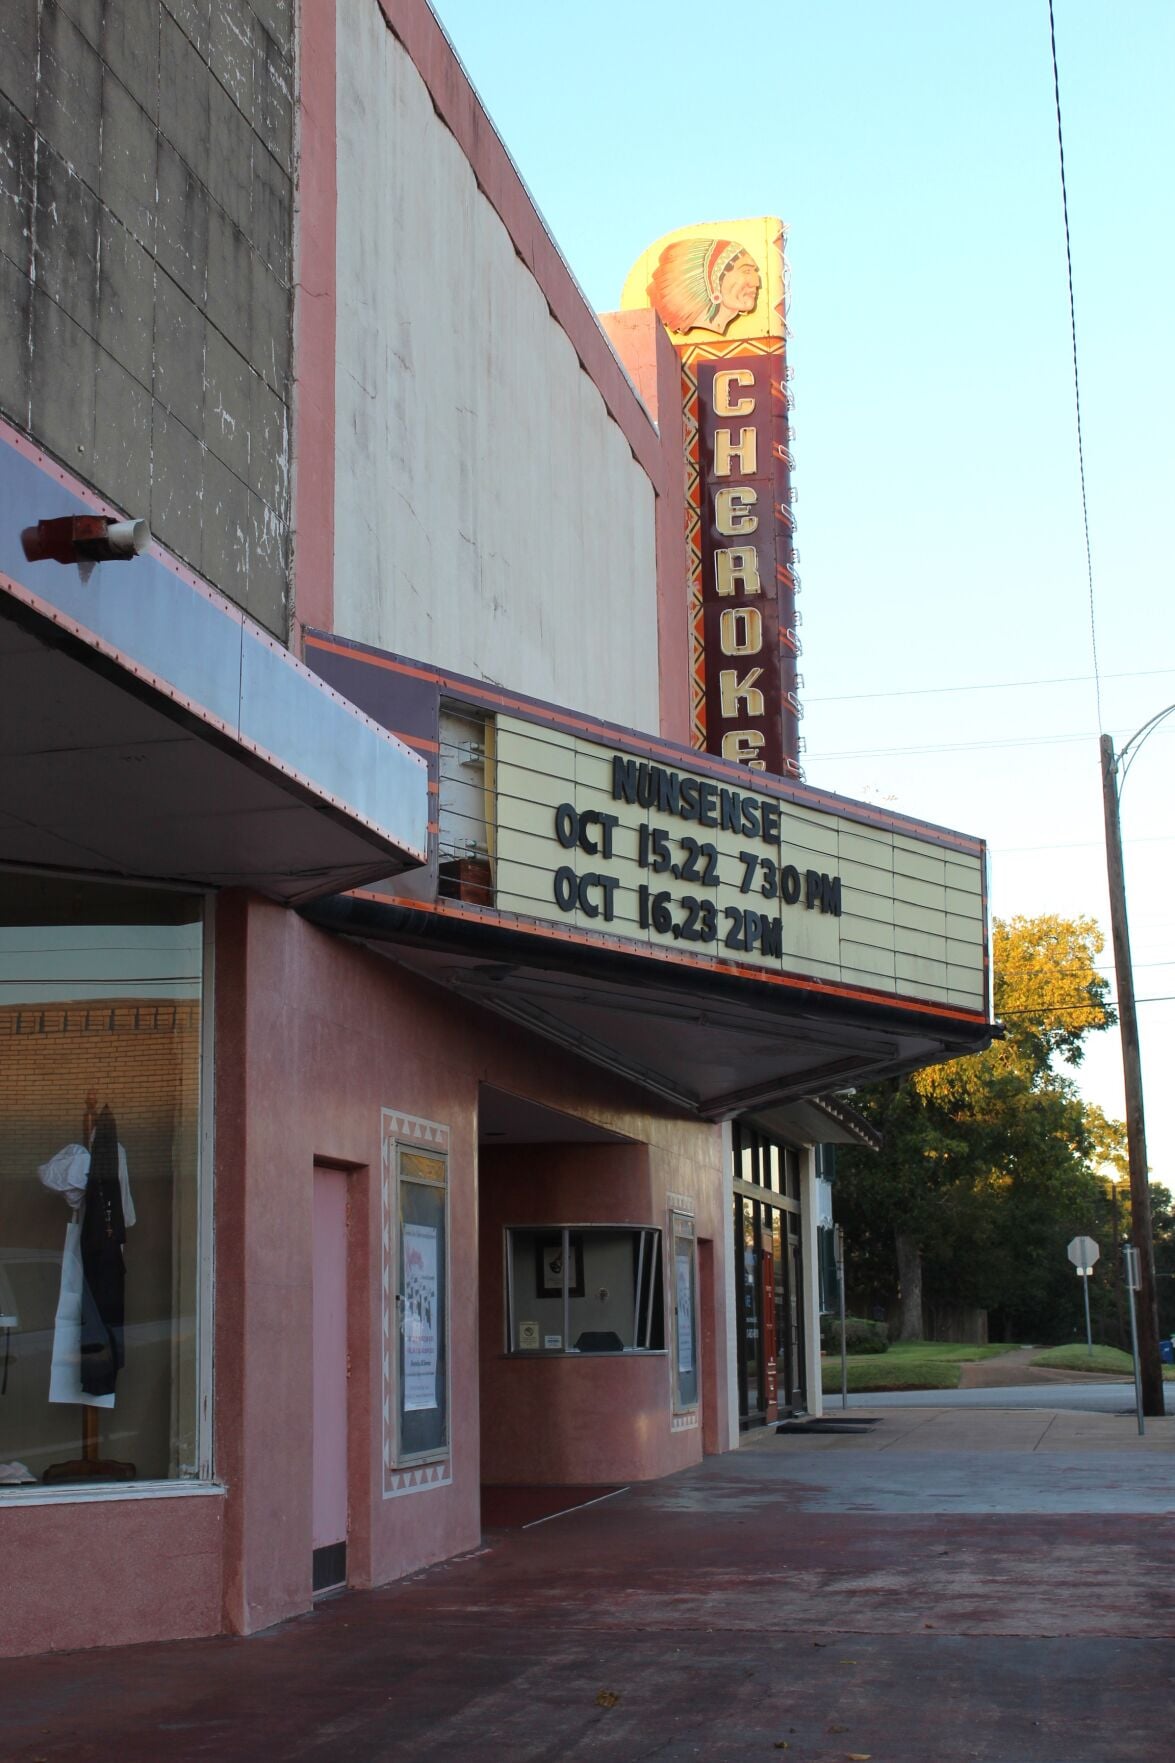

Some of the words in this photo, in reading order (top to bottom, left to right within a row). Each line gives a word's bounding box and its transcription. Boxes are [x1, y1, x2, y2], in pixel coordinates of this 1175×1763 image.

[613, 755, 781, 845] NUNSENSE
[556, 802, 619, 859] OCT
[639, 823, 720, 886] 15,22
[554, 865, 620, 922] OCT
[639, 884, 717, 943] 16,23
